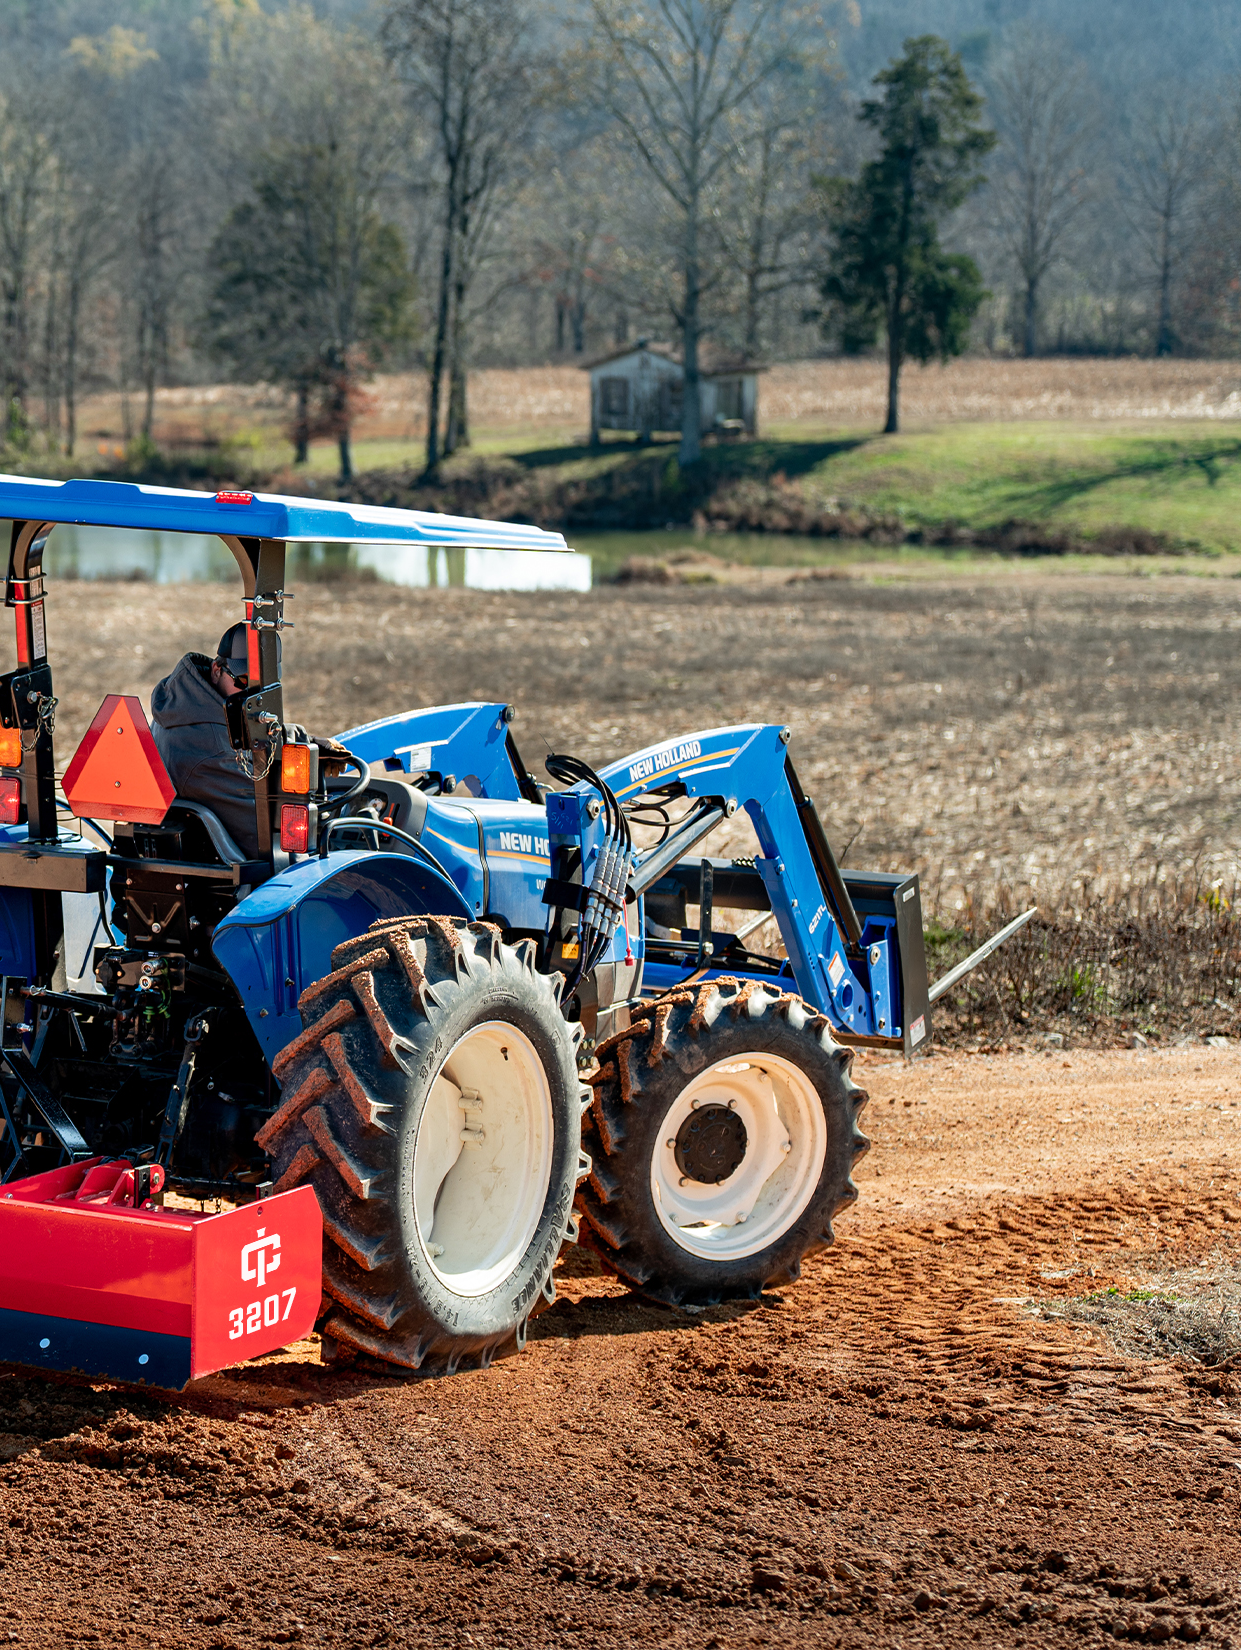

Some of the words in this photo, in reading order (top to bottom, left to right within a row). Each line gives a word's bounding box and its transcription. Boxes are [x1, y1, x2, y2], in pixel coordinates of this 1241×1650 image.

[629, 757, 654, 782] NEW
[654, 741, 701, 771] HOLLAND
[499, 831, 532, 853] NEW
[809, 904, 827, 934] 621TL
[511, 1202, 565, 1318] ALLIANCE
[228, 1287, 297, 1340] 3207
